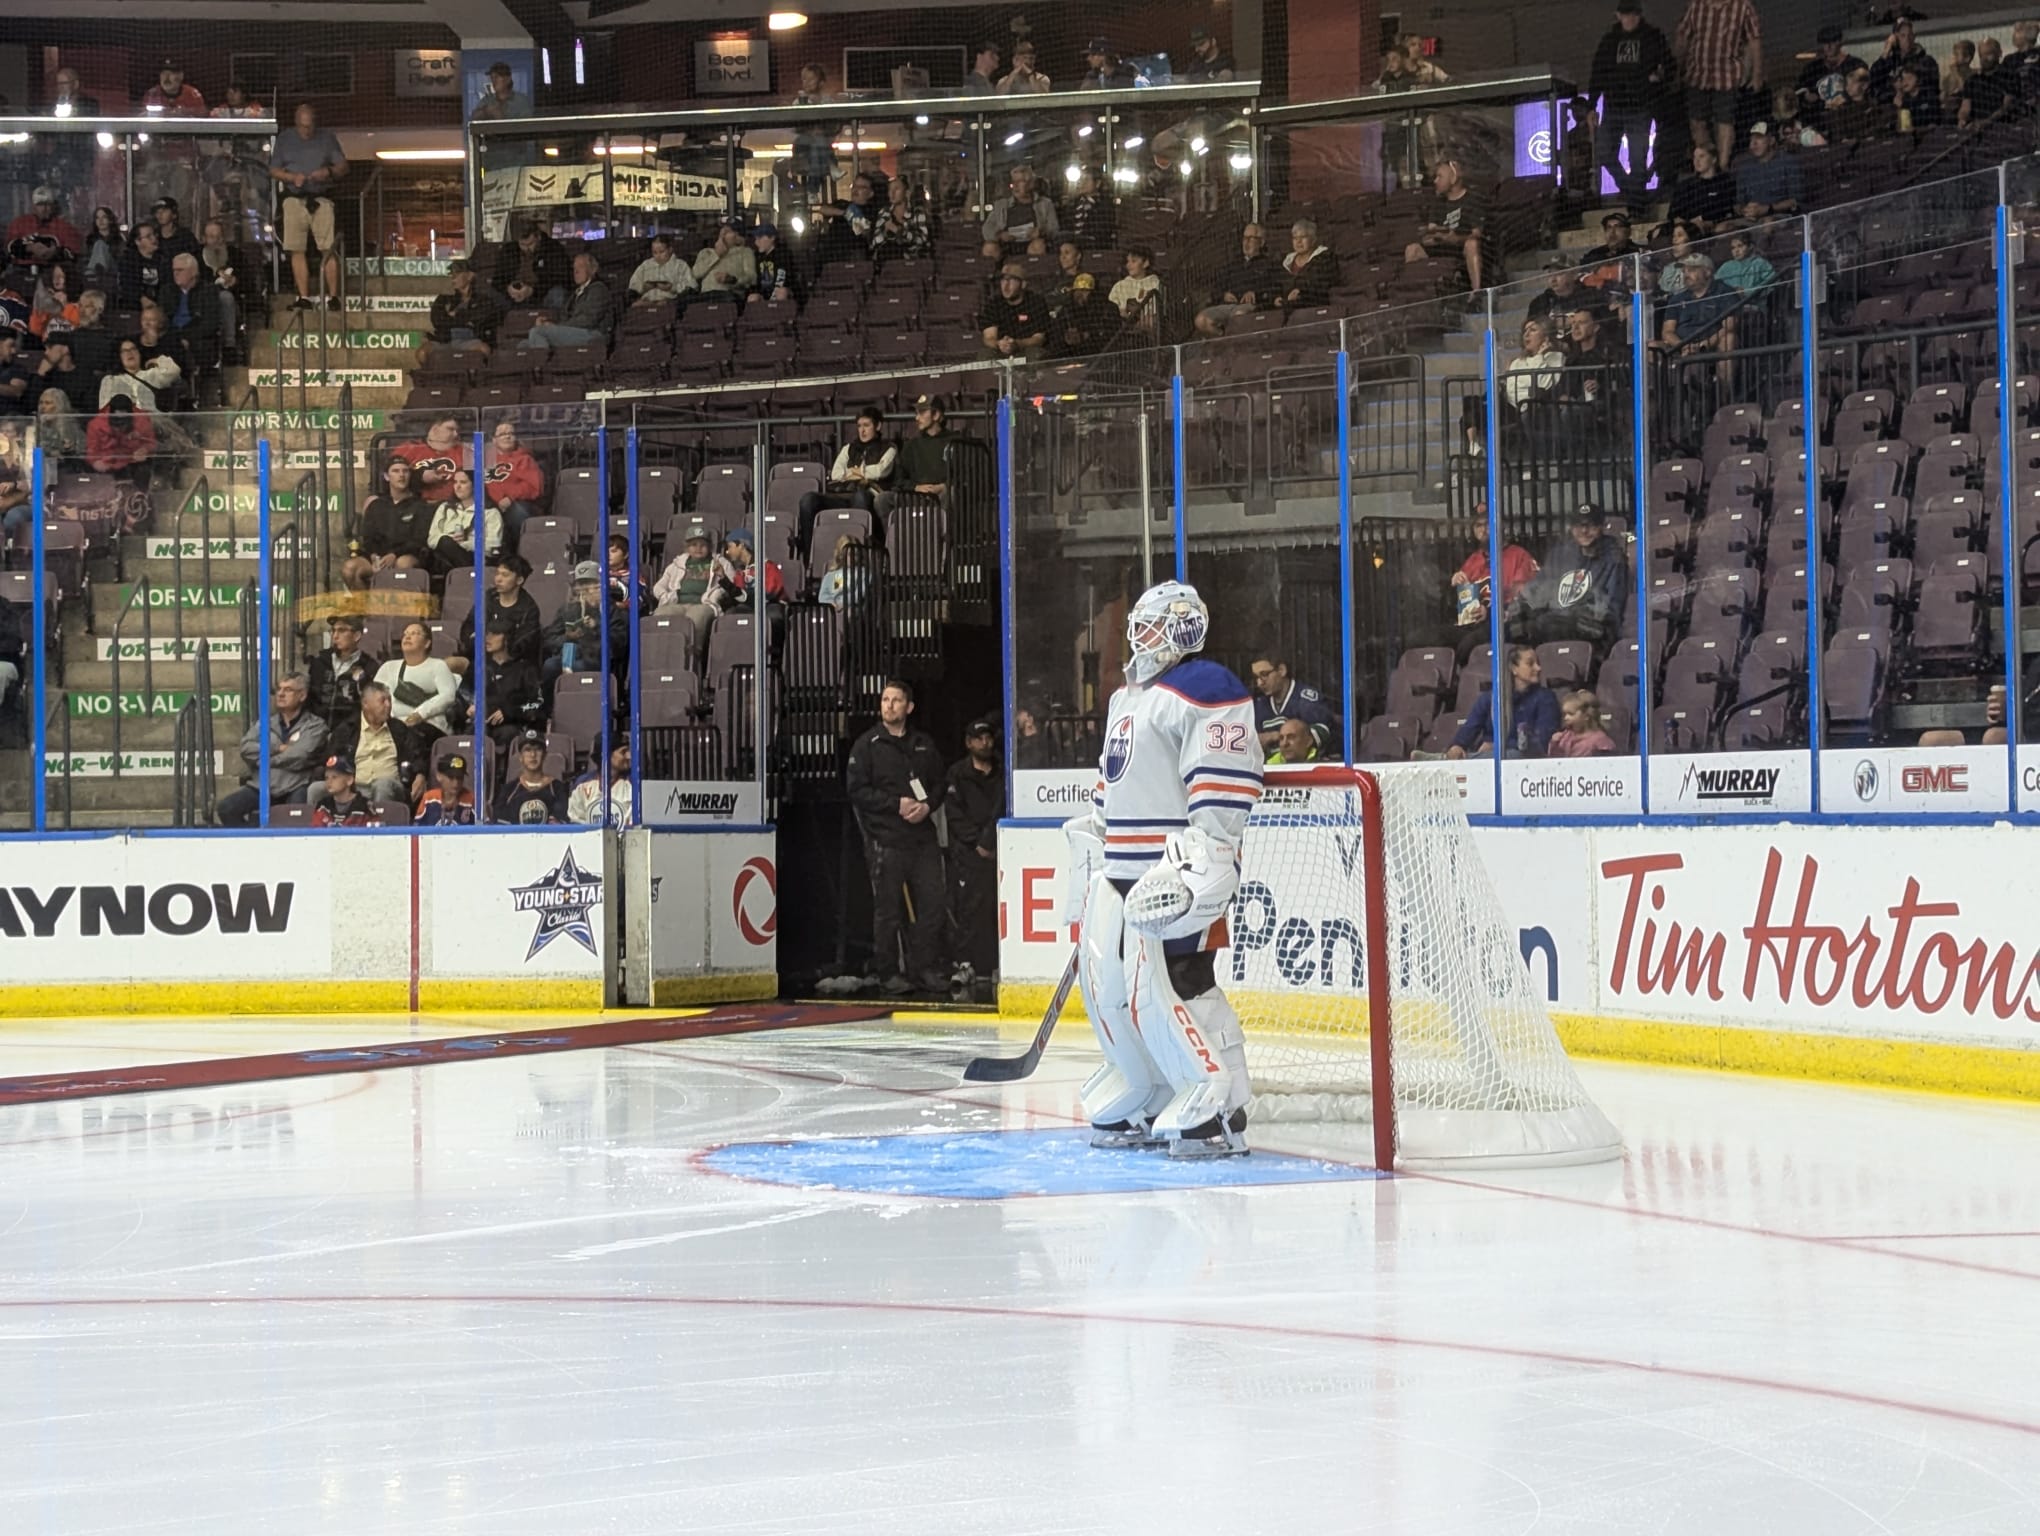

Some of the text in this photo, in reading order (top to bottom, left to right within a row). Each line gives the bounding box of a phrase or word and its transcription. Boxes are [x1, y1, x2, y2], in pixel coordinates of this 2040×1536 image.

[408, 56, 455, 69] Craft
[708, 54, 751, 66] Beer
[279, 333, 410, 349] NORVAL.COM
[335, 373, 397, 383] RENTALS
[1206, 721, 1249, 754] 32
[1520, 776, 1624, 797] Certified Service
[1698, 768, 1781, 795] MURRAY
[1902, 764, 1969, 792] GMC
[680, 793, 739, 812] MURRAY
[514, 889, 565, 910] YOUNG
[1231, 879, 1559, 1002] Penicton
[1601, 846, 2040, 1022] Tim Hortons
[1173, 1004, 1220, 1073] CCM
